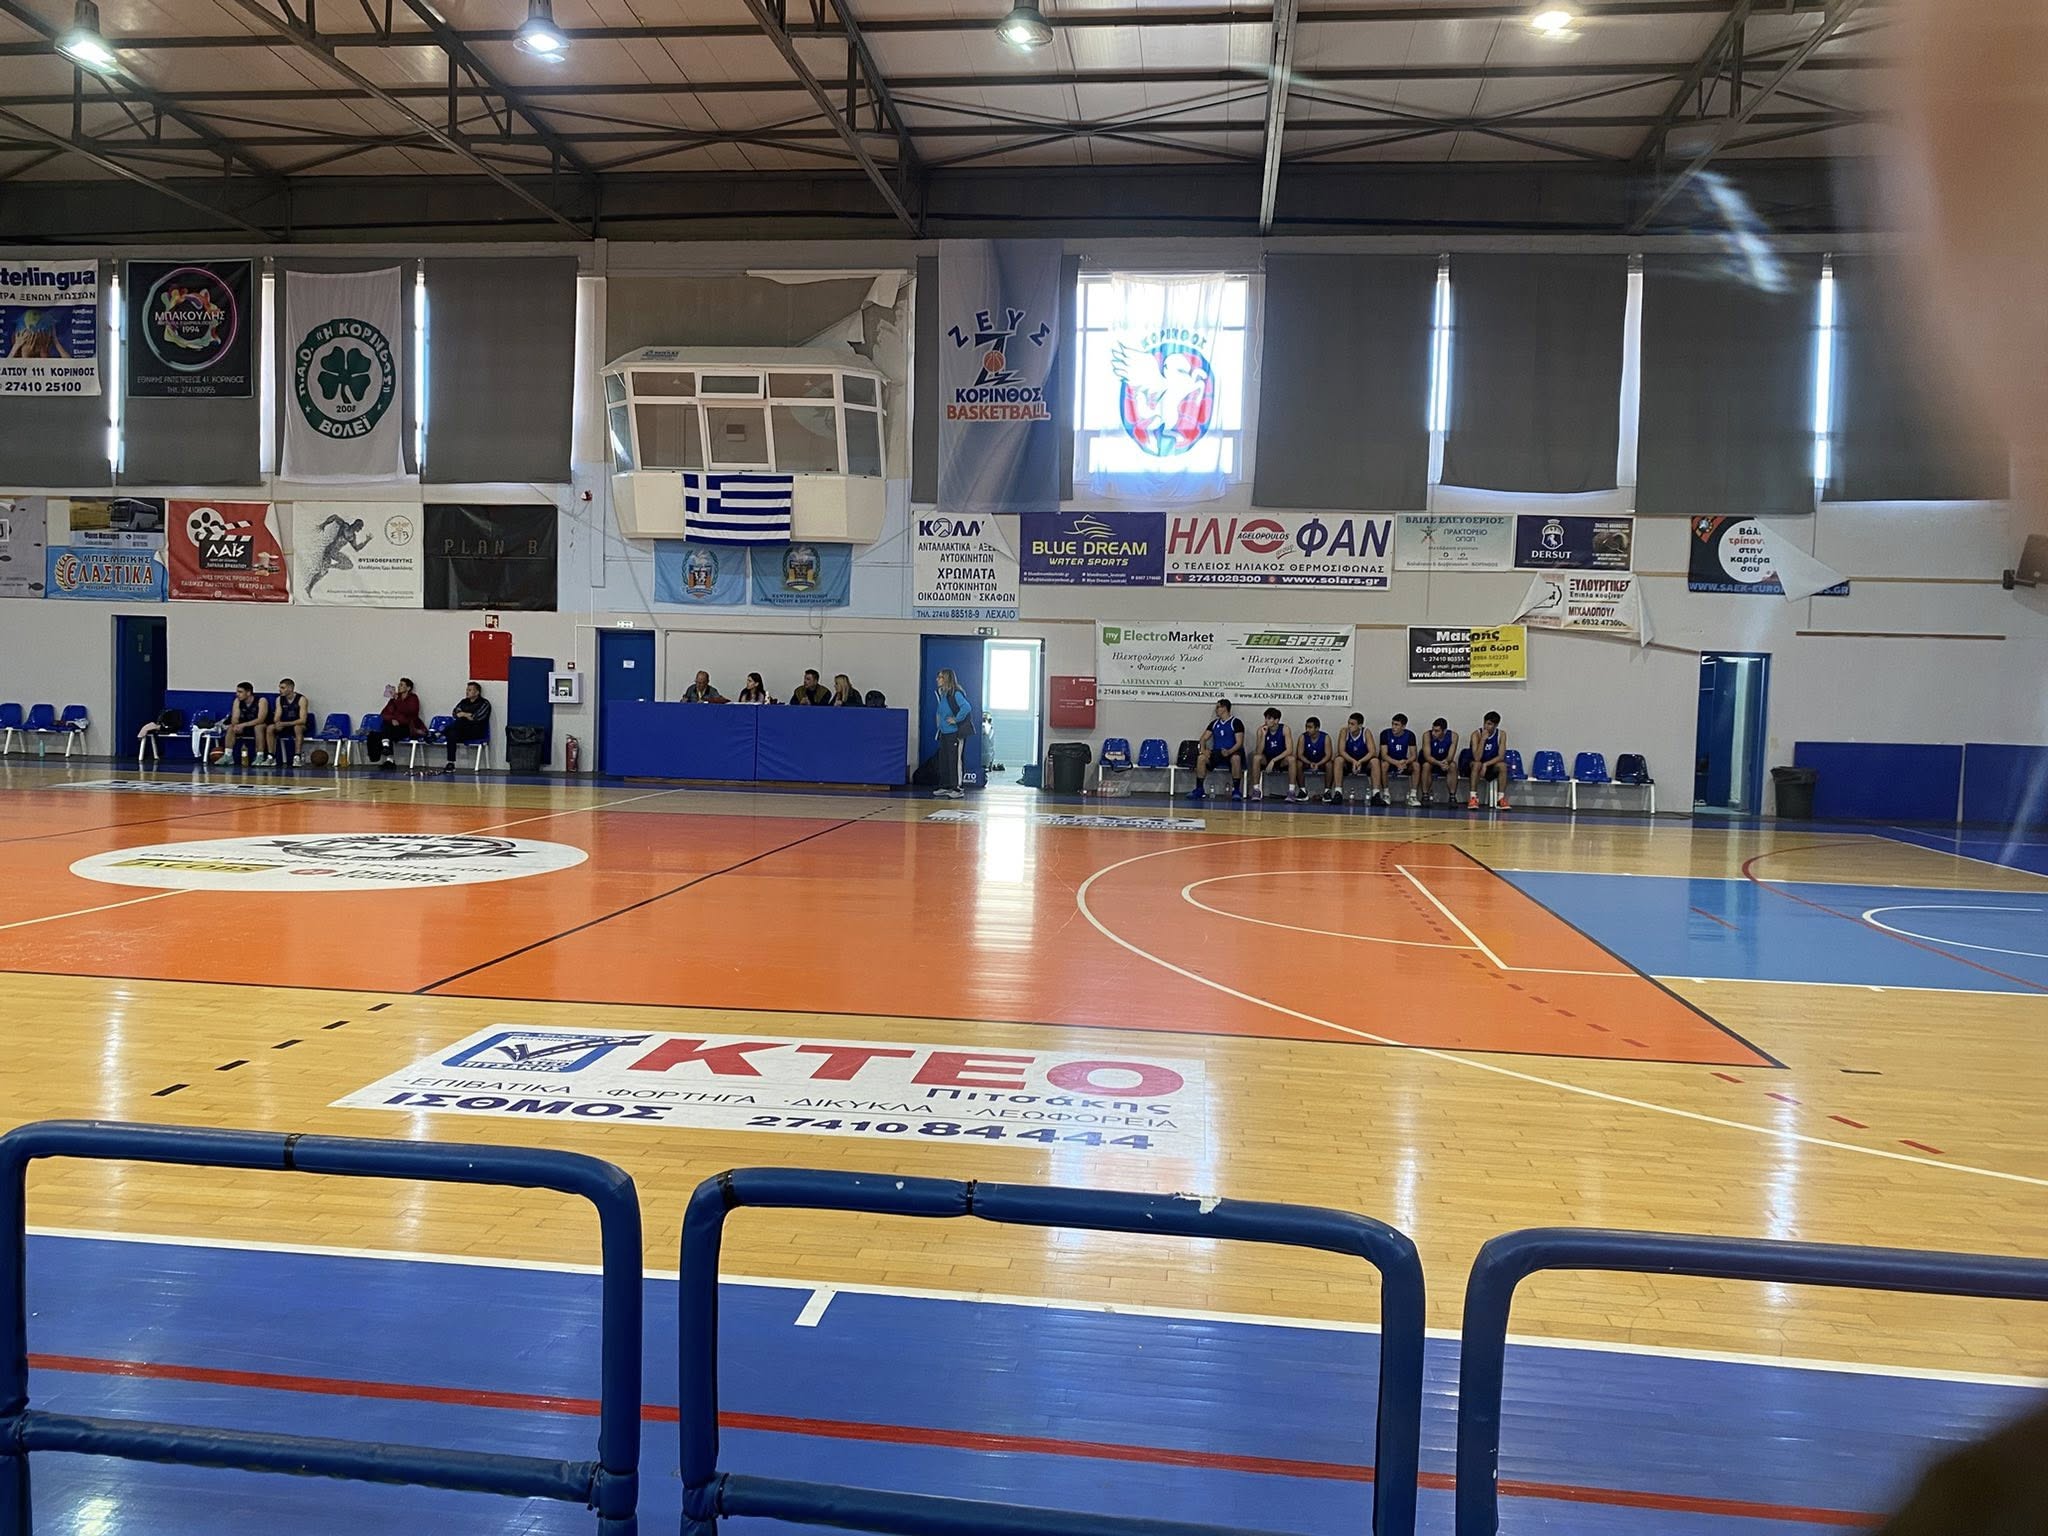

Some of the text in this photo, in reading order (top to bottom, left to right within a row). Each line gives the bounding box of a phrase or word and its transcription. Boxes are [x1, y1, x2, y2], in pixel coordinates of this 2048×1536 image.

[20, 293, 51, 301] ΞΕΝΩΝ
[54, 292, 95, 300] ΓΛΩΣΣΩΝ
[155, 311, 225, 321] ΜΠΑΚΟΥΛΗΣ
[948, 309, 1050, 348] ΖΕΥΣ
[32, 367, 45, 376] 111
[51, 367, 95, 377] ΚΟΡΙΝΘΟΣ
[5, 381, 81, 392] 27410 25100
[955, 388, 1042, 402] ΚΟΡΙΝΘΟΣ
[947, 404, 1049, 420] BASKETBALL
[319, 416, 372, 437] ΒΟΛΕΪ
[919, 517, 984, 538] ΚΟΛΛ
[1739, 527, 1761, 535] Βάλ
[1237, 532, 1290, 540] AGELOPOULOS
[1729, 537, 1765, 545] τρίπον
[444, 539, 537, 555] PLAN B
[918, 542, 996, 551] ΑΝΤΑΛΛΑΚΤΙΚΑ ΑΞΕ
[1032, 541, 1147, 555] BLUE DREAM
[82, 554, 151, 564] ΜΠΙΣΜΠΙΚΗΣ
[940, 554, 994, 563] ΑΥΤΟΚΙΝΗΤΩΝ
[1532, 550, 1572, 559] DERSUT
[1730, 555, 1770, 564] καριέρα
[1049, 558, 1129, 566] WATER SPORTS
[1172, 562, 1385, 573] Ο ΤΕΛΕΙΟΣ ΗΛΙΑΚΟΣ ΘΕΡΜΟΣΙΦΩΝΑΣ
[67, 563, 153, 584] ΕΛΑΣΤΙΚΑ
[937, 568, 996, 579] ΧΡΩΜΑΤΑ
[1188, 575, 1380, 586] 2741028300 www.solars.gr
[936, 582, 997, 591] ΑΥΤΟΚΙΝΗΤΩΝ
[918, 592, 1016, 602] ΟΙΚΟΔΟΜΩΝ ΣΚΑΦΩΝ
[950, 609, 980, 618] 88518-9
[985, 610, 1015, 619] ΛΕΧΑΙΟ
[1105, 630, 1214, 643] my ElectroMarket
[1436, 631, 1500, 642] Μακρής
[1490, 643, 1519, 653] δώρα
[1112, 652, 1204, 663] Ηλεκτρολογικό Υλικό
[1247, 655, 1335, 666] Ηλεκτρικά Σκούτερ
[1137, 663, 1177, 672] Φωτισμός
[1247, 665, 1334, 676] Πατίνια Ποδήλατα
[129, 861, 265, 872] JACOBS
[458, 1061, 566, 1073] ΠΙΤΣΑΚΗΣ
[627, 1038, 1185, 1097] ΚΤΕΟ
[382, 1091, 673, 1121] ΙΣΘΜΟΣ
[408, 1077, 1178, 1130] ΕΠΙΒΑΤΙΚΑ ΦΟΡΤΗΓΑ ΔΙΚΥΚΛΑ ΛΕΩΦΟΡΕΙΑ
[926, 1087, 1171, 1116] Πιτσάκης
[745, 1115, 1154, 1150] 27410 84444
